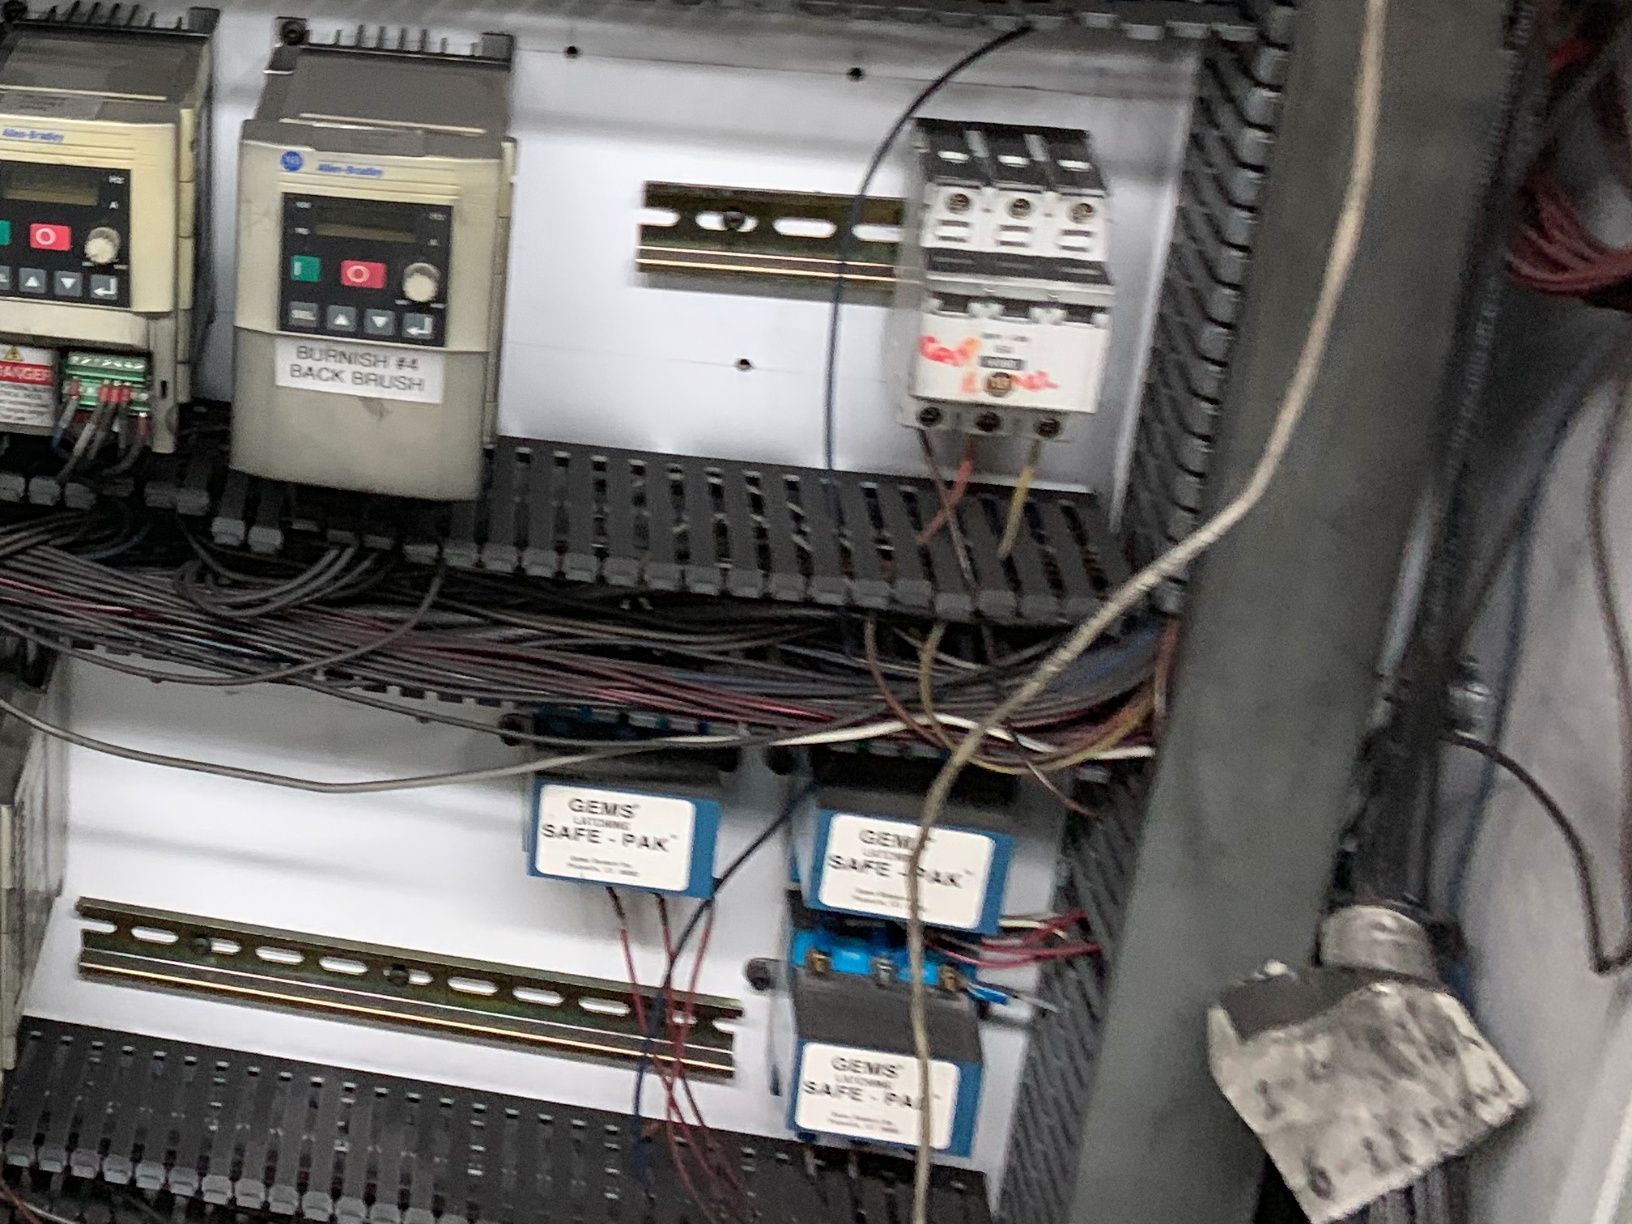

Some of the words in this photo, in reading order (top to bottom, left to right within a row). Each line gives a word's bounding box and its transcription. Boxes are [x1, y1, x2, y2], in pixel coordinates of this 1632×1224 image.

[296, 345, 388, 370] BURNISH
[396, 357, 419, 371] #4
[289, 363, 346, 385] BACK
[350, 370, 425, 393] BRUSH
[568, 797, 636, 819] GEMS
[542, 823, 602, 844] SAFE
[621, 831, 669, 852] PAK
[828, 854, 891, 878] SAFE
[831, 1056, 898, 1079] GEMS
[802, 1080, 863, 1102] SAFE
